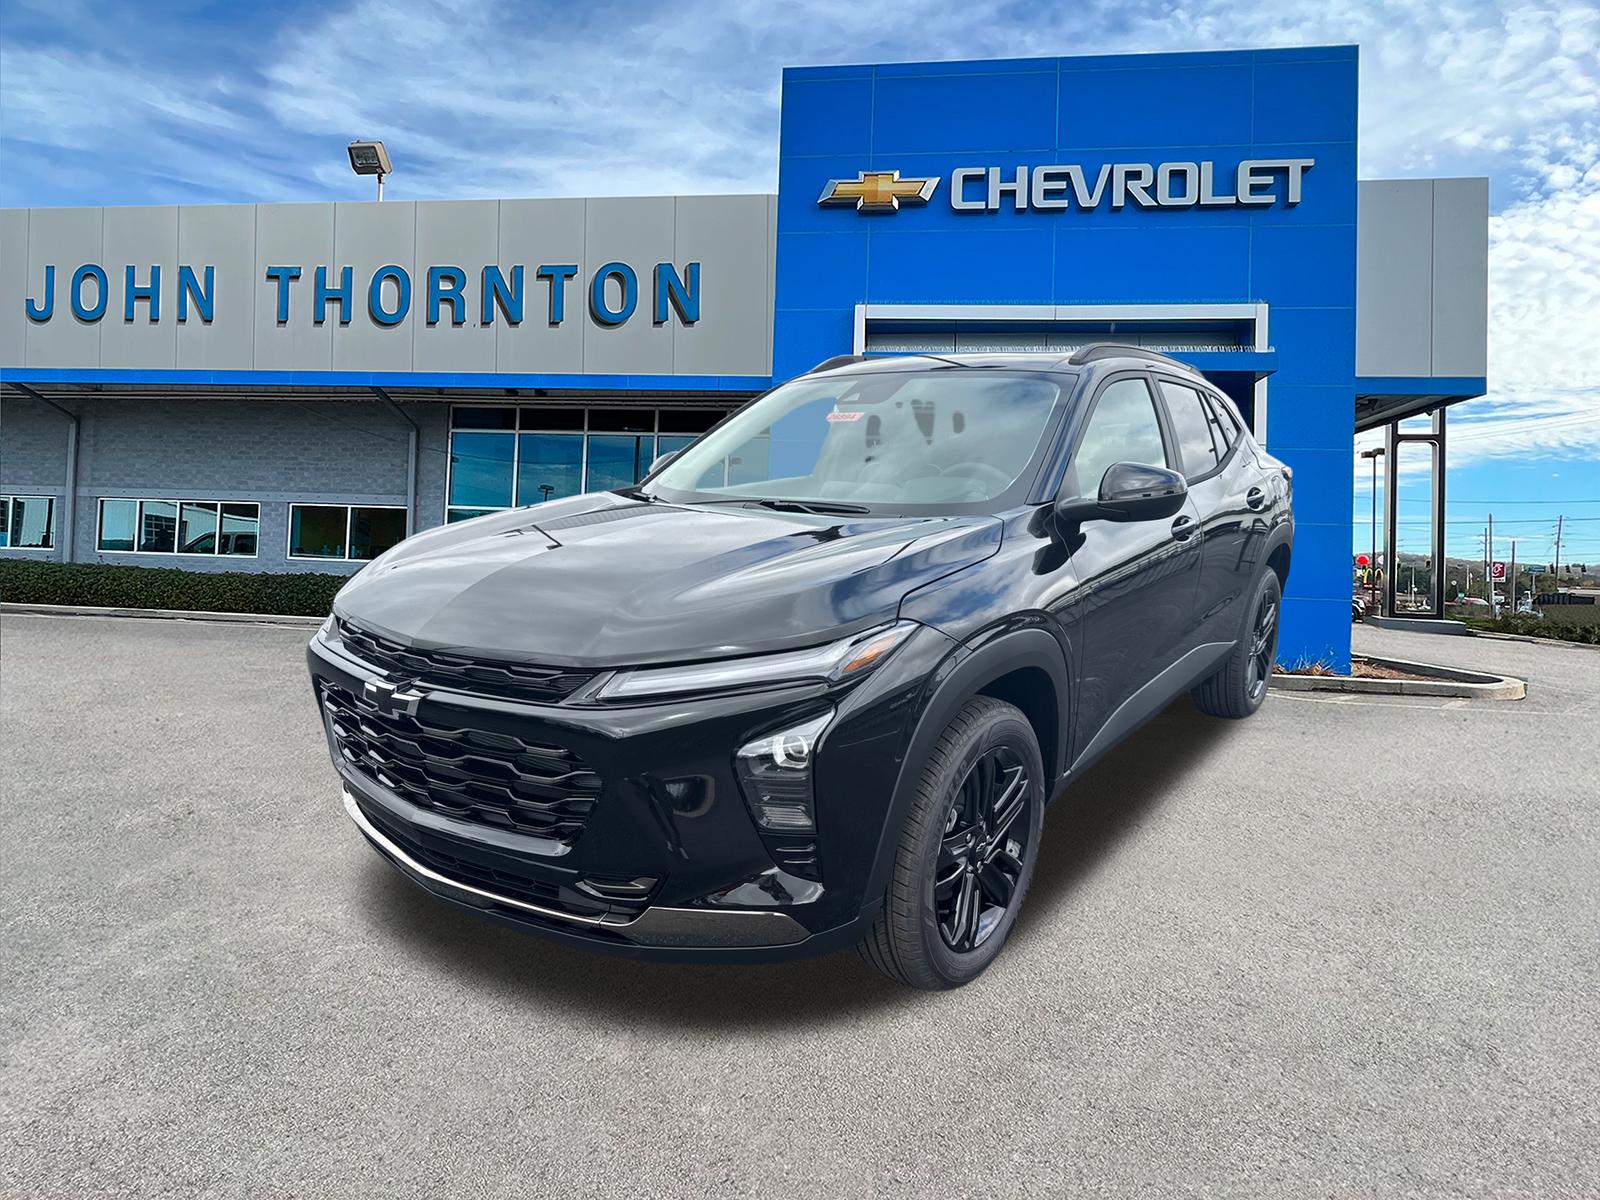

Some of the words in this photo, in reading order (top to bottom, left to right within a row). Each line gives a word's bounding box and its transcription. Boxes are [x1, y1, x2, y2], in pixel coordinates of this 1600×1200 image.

[951, 158, 1316, 213] CHEVROLET
[25, 264, 216, 325] JOHN
[266, 262, 702, 328] THORNTON
